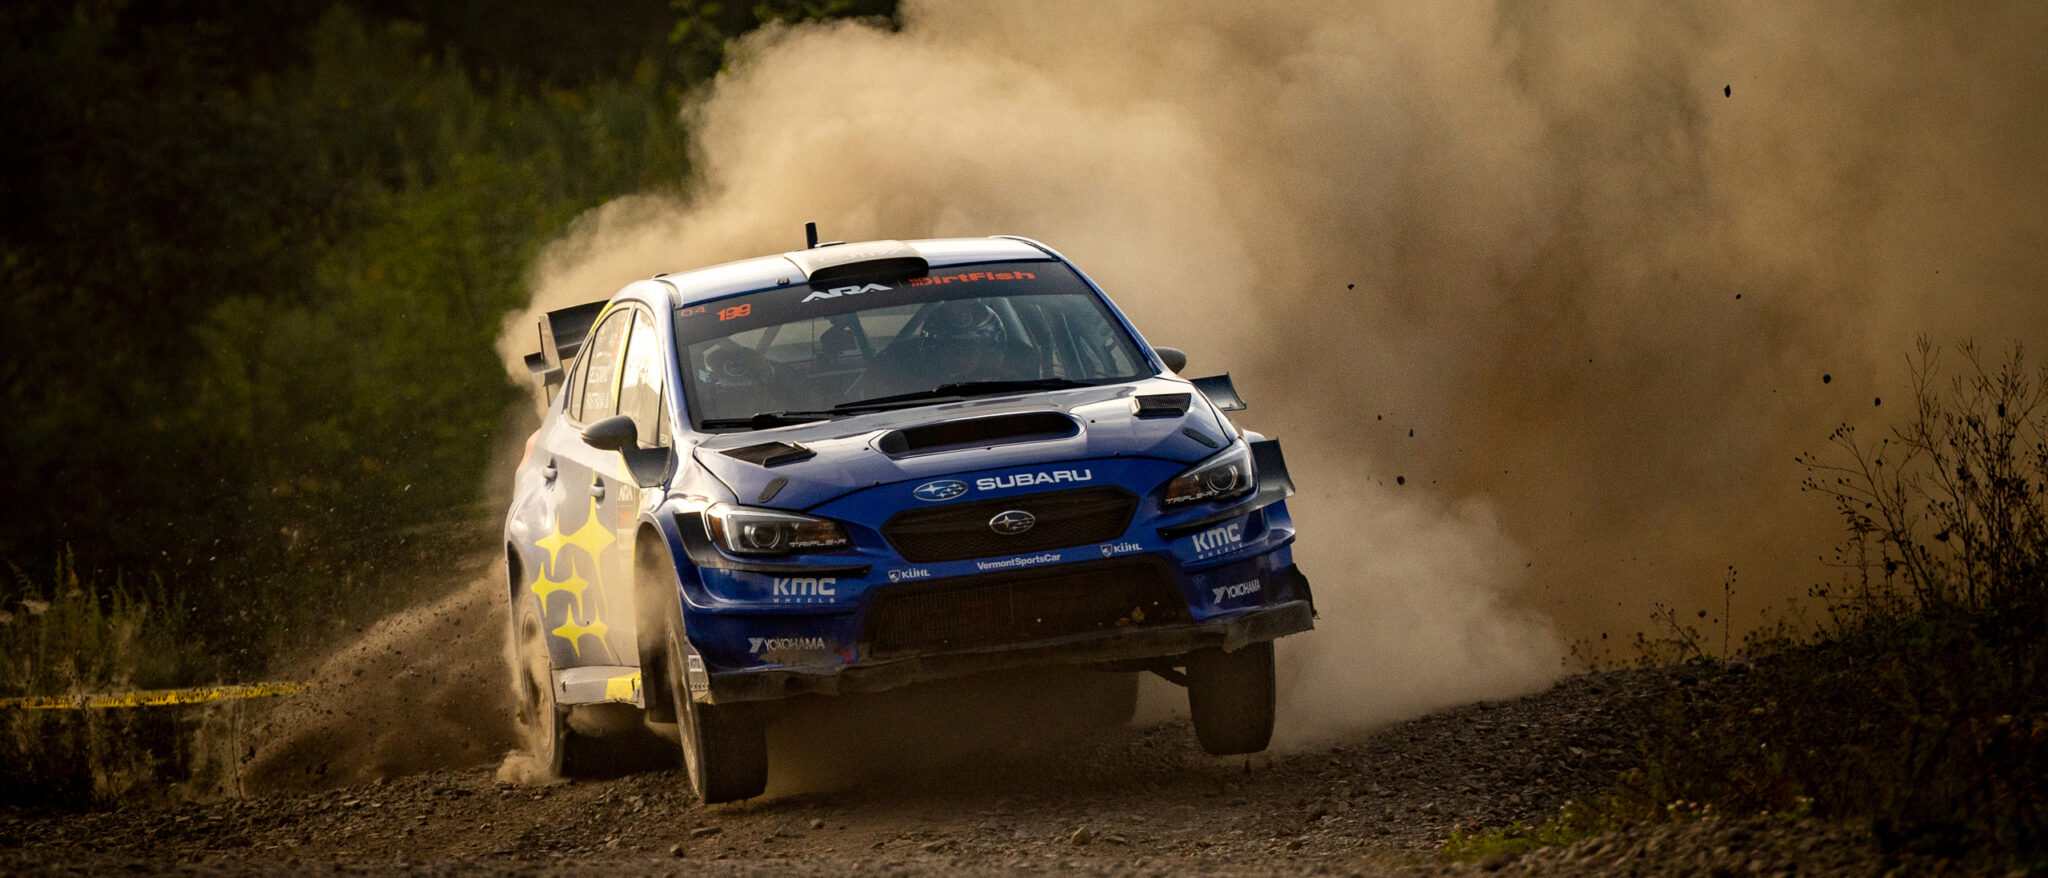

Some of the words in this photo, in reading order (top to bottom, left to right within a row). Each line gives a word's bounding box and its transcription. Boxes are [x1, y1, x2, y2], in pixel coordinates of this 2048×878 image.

[908, 271, 1035, 287] DirtFish
[801, 283, 893, 303] ARA
[716, 303, 751, 322] 199
[976, 469, 1092, 491] SUBARU
[1113, 543, 1142, 553] KÜHL
[977, 554, 1061, 570] VermontSportsCar
[901, 568, 931, 579] KÜHL
[1226, 579, 1261, 599] YOKOHAMA
[764, 637, 825, 651] YOKOHAMA
